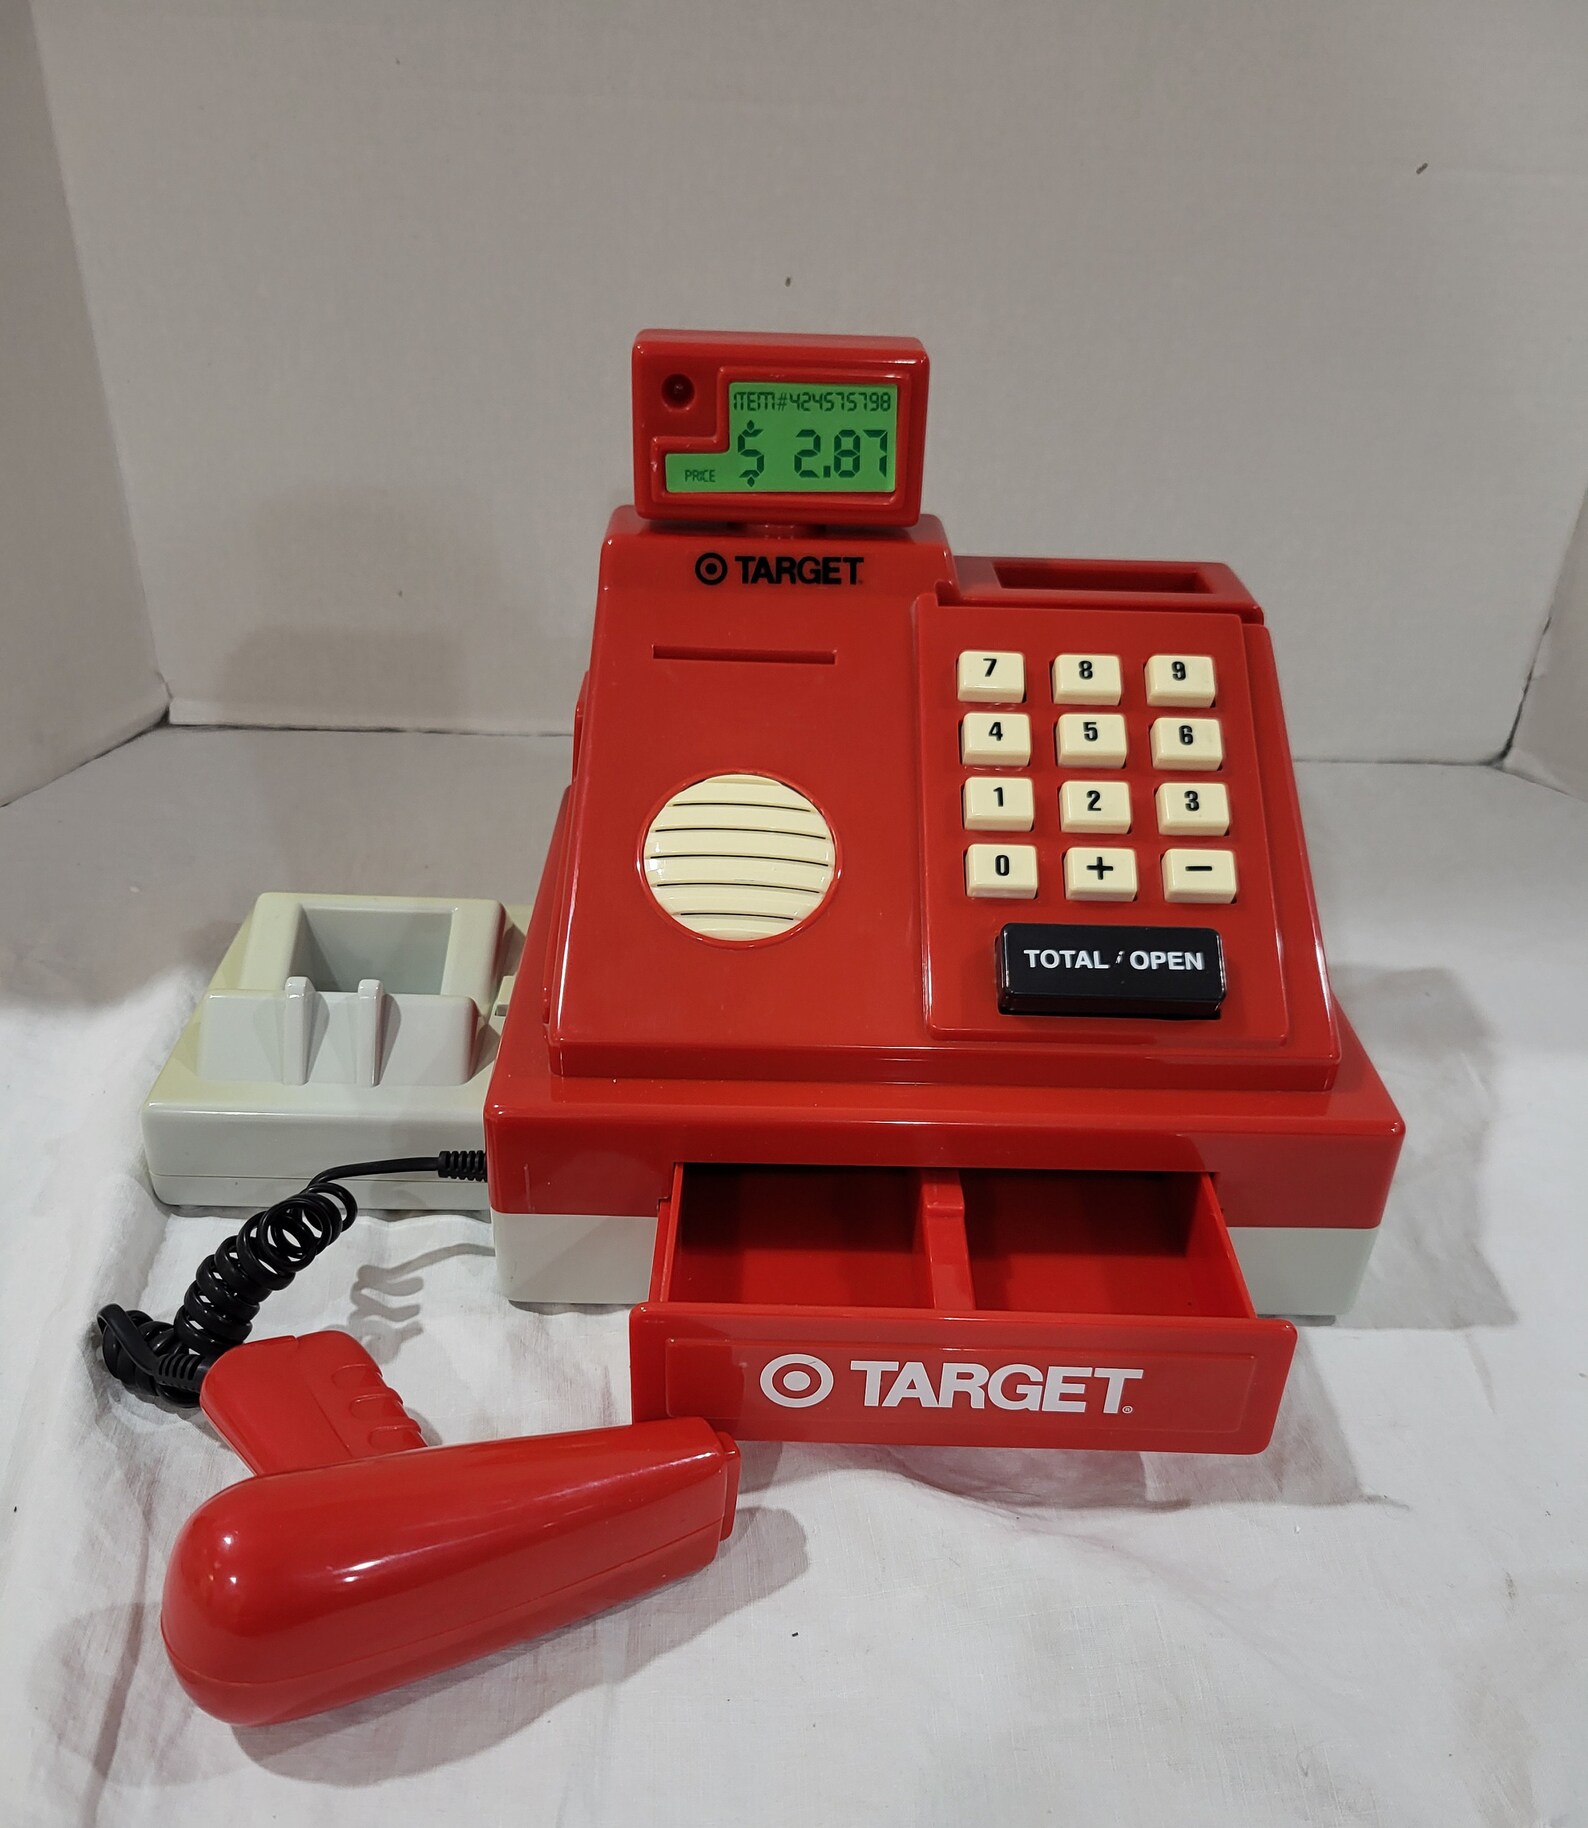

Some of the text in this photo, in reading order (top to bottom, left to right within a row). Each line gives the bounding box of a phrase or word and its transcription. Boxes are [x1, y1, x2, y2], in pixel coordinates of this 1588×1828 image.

[737, 420, 888, 488] $ 2.87
[684, 469, 716, 483] PRICE
[734, 556, 864, 585] TARGET
[982, 657, 998, 678] 7
[1078, 660, 1094, 680] 8
[1172, 661, 1187, 681] 9
[988, 721, 1004, 742] 4
[1083, 721, 1099, 742] 5
[1178, 725, 1194, 746] 6
[993, 786, 1005, 807] 1
[1086, 790, 1102, 812] 2
[1184, 790, 1200, 812] 3
[995, 854, 1010, 877] 0
[1086, 856, 1114, 880] +
[1023, 949, 1110, 969] TOTAL
[1129, 951, 1205, 970] OPEN
